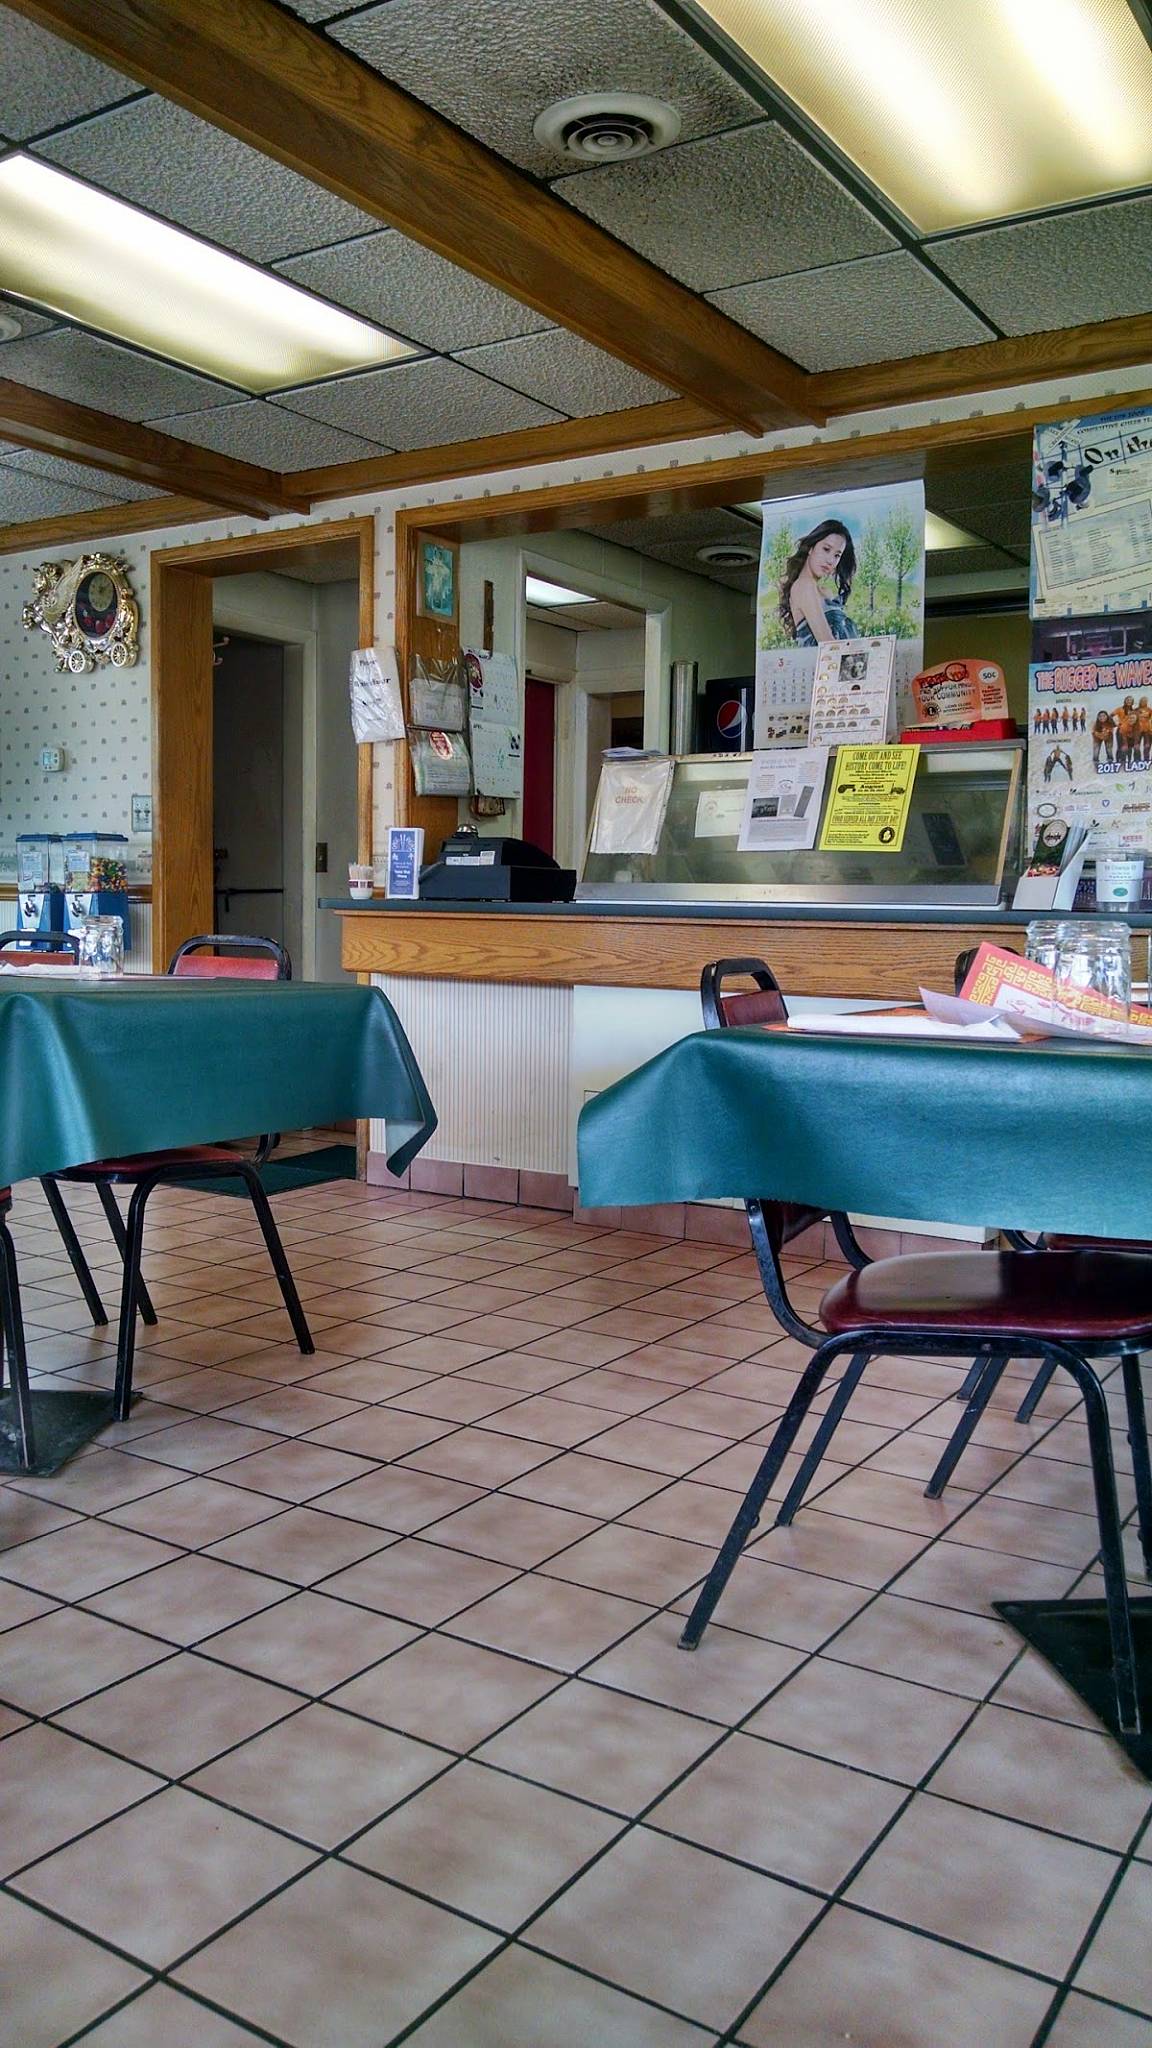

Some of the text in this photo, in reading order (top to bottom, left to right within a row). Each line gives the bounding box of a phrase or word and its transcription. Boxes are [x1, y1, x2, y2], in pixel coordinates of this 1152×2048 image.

[1085, 448, 1120, 464] On
[1036, 671, 1054, 691] THE
[1054, 664, 1097, 693] BIGGER
[1098, 666, 1115, 686] THE
[853, 750, 903, 760] COME OUT AND SEE
[1097, 760, 1152, 774] 2017 LADY
[624, 785, 638, 793] NO
